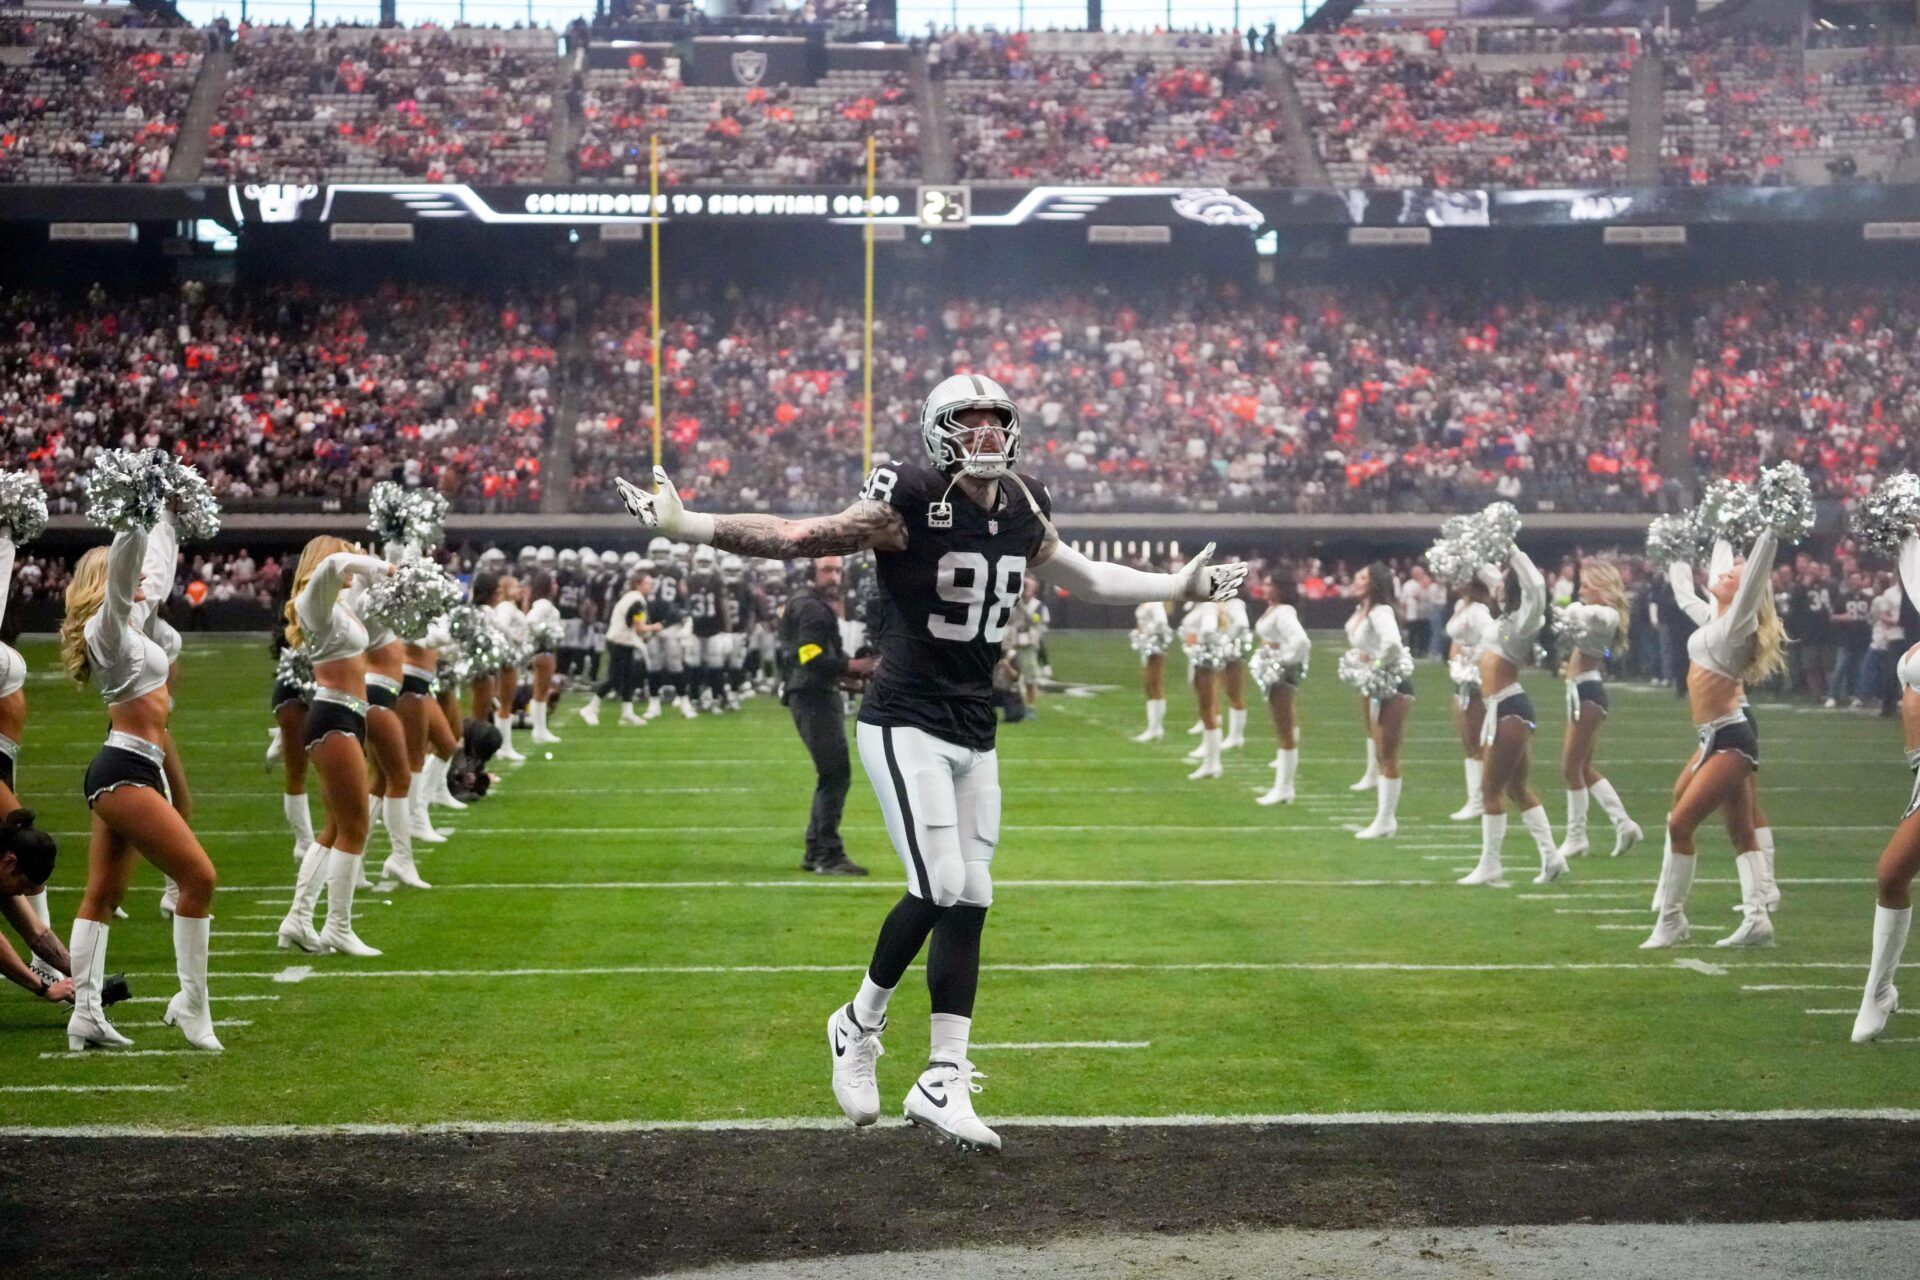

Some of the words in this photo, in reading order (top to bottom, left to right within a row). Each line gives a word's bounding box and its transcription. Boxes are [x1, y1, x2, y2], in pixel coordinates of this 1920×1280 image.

[525, 193, 667, 213] COUNTDOWN
[672, 194, 703, 214] TO
[708, 195, 828, 214] SHOWTIME
[690, 593, 716, 617] 31
[921, 551, 1027, 643] 98
